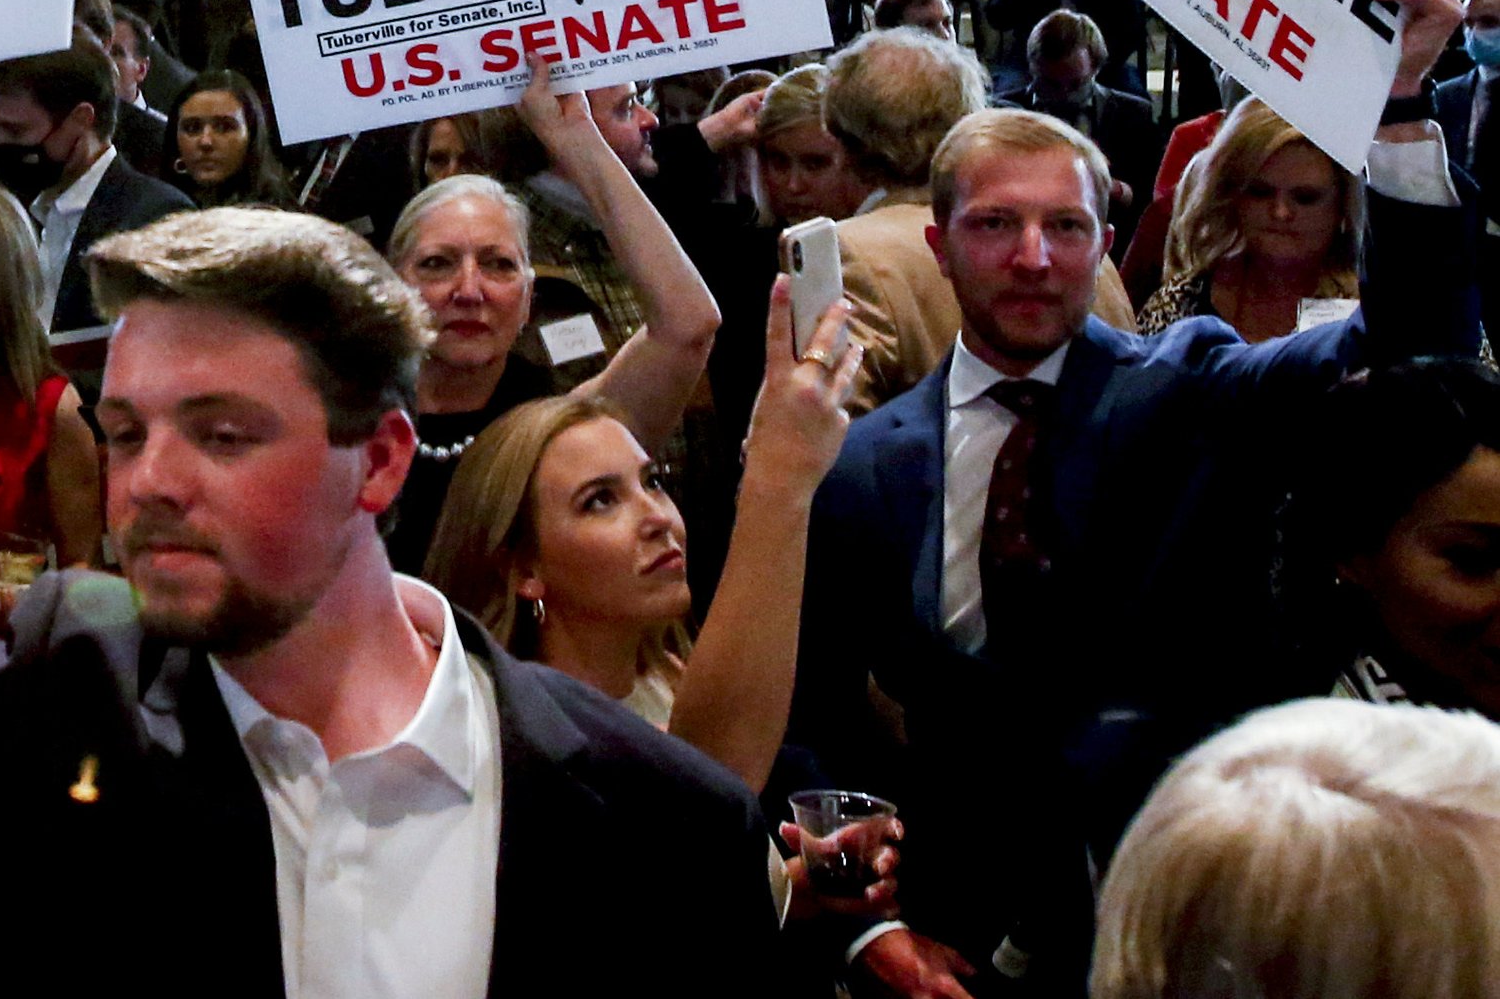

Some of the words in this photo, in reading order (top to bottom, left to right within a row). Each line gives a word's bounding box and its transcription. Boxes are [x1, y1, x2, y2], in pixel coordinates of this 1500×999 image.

[323, 23, 406, 50] Tuberville
[410, 17, 434, 32] for
[438, 6, 504, 27] Senate,
[508, 0, 539, 14] Inc.
[1232, 37, 1246, 53] AL
[341, 43, 461, 98] U.S.
[438, 87, 450, 97] BY
[453, 76, 508, 94] TUBERVILLE
[509, 72, 530, 83] FOR
[589, 58, 609, 68] BOX
